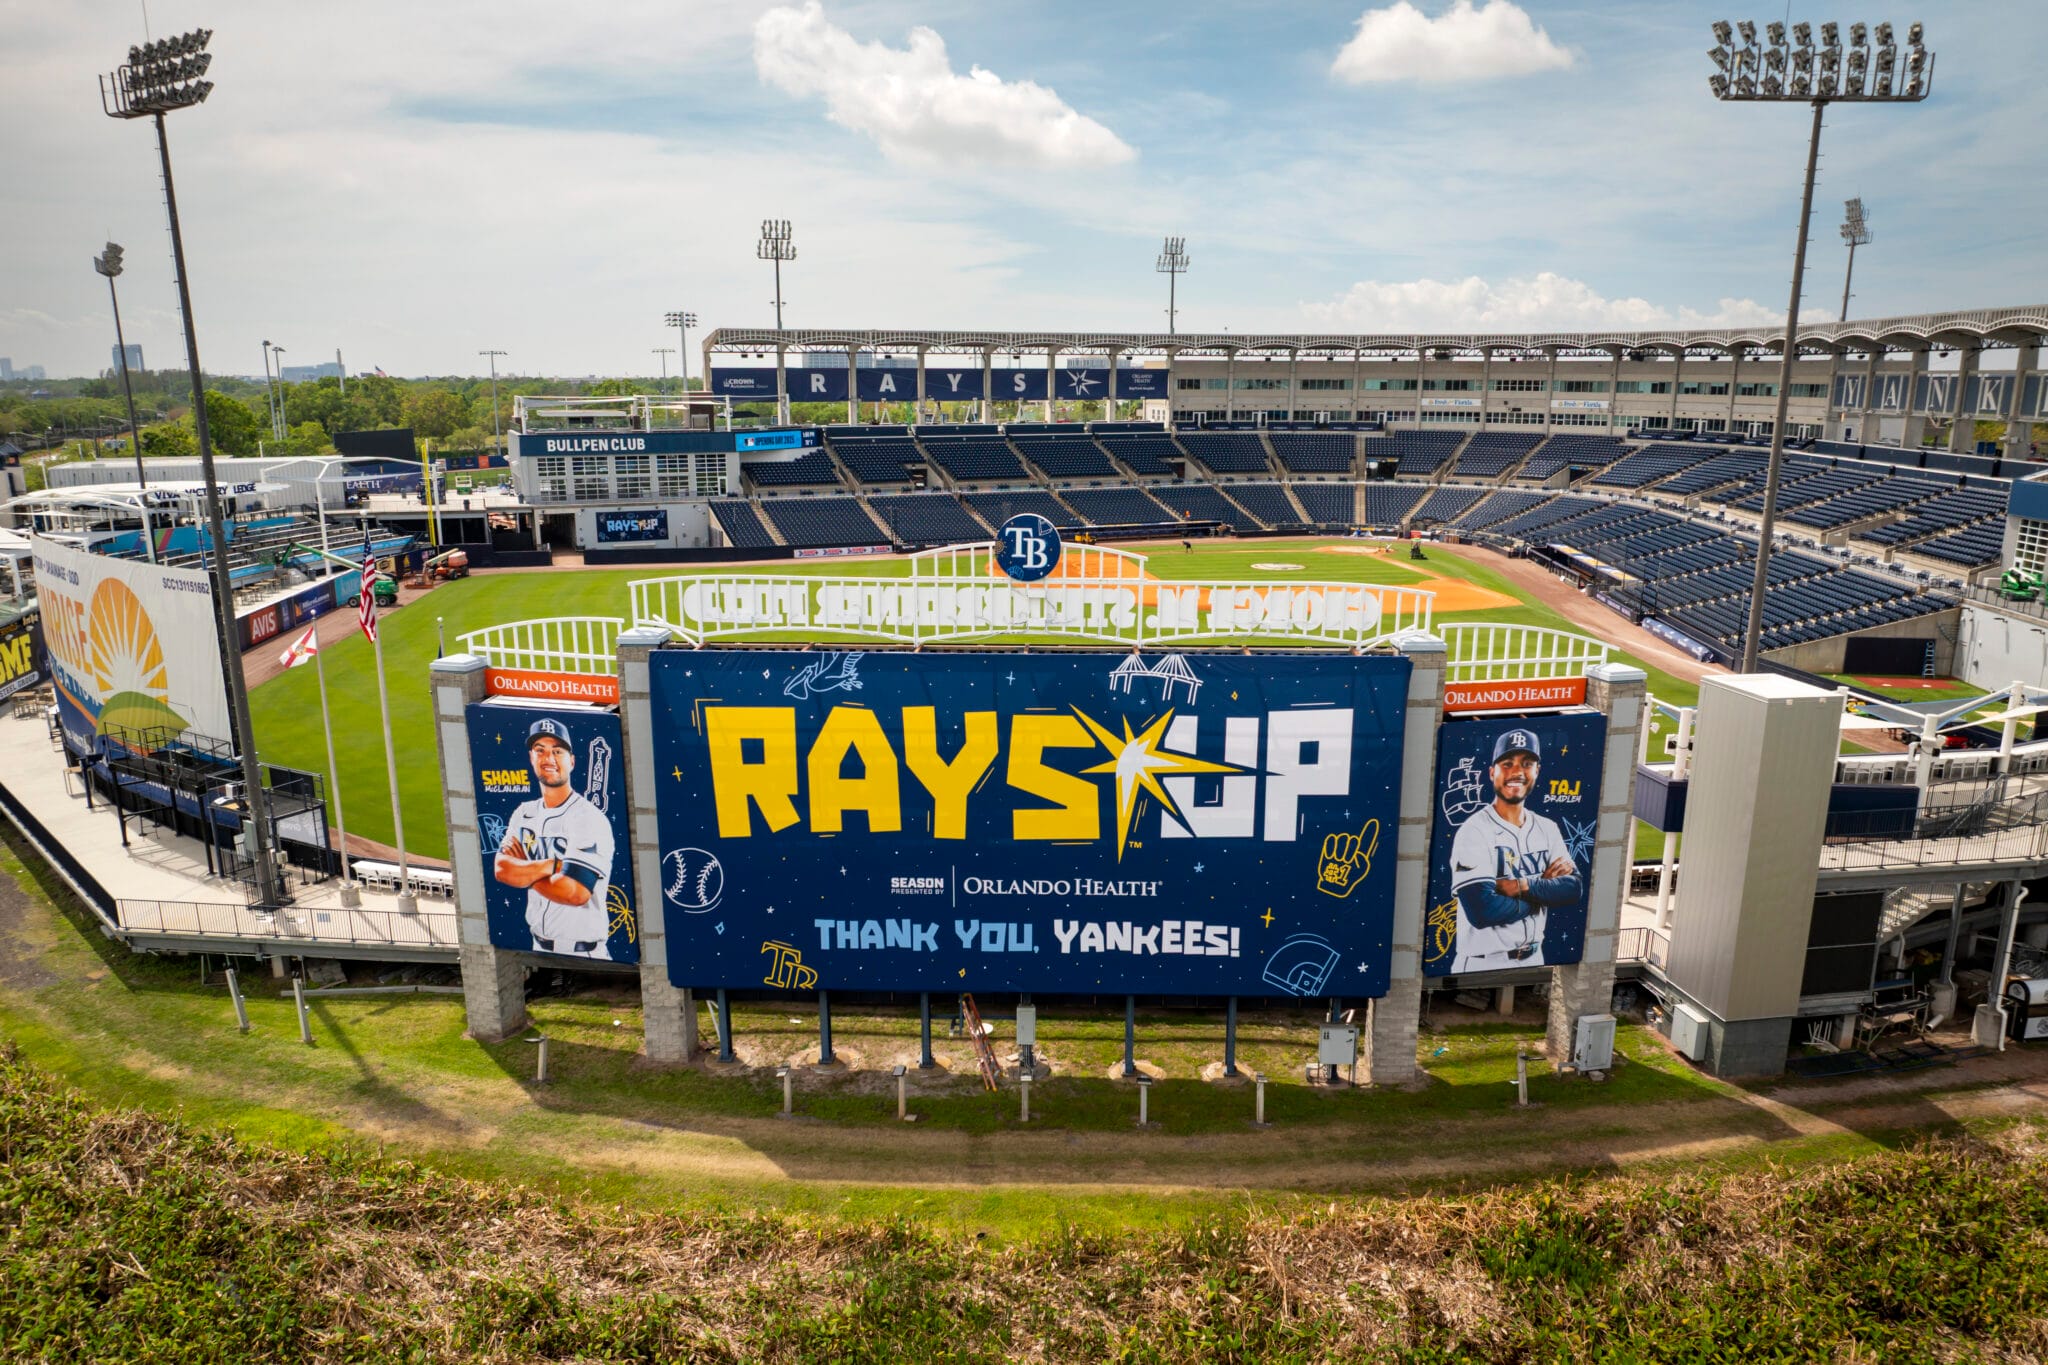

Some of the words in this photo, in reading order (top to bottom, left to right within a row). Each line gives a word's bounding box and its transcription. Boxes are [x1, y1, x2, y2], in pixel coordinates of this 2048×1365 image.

[547, 439, 608, 452] BULLPEN
[611, 438, 645, 451] CLUB
[185, 486, 227, 497] VCTRY
[233, 482, 256, 494] LEDGE
[607, 519, 640, 532] RAYS
[643, 518, 658, 530] UP
[1005, 527, 1048, 568] TB
[252, 612, 277, 640] AVIS
[494, 676, 559, 692] ORLANDO
[561, 681, 616, 697] HEALTH
[1445, 690, 1515, 705] ORLANDO
[1518, 687, 1572, 701] HEALTH
[481, 770, 530, 786] SHANE
[705, 706, 1100, 840] RAYS
[1161, 708, 1354, 841] UP
[1549, 780, 1581, 796] TAJ
[891, 877, 944, 888] SEASON
[1323, 862, 1351, 887] #1
[963, 876, 1070, 896] ORLANDO
[1074, 879, 1158, 896] HEALTH
[814, 918, 940, 952] THANK
[954, 919, 1039, 954] YOU,
[1053, 919, 1240, 957] YANKEES!
